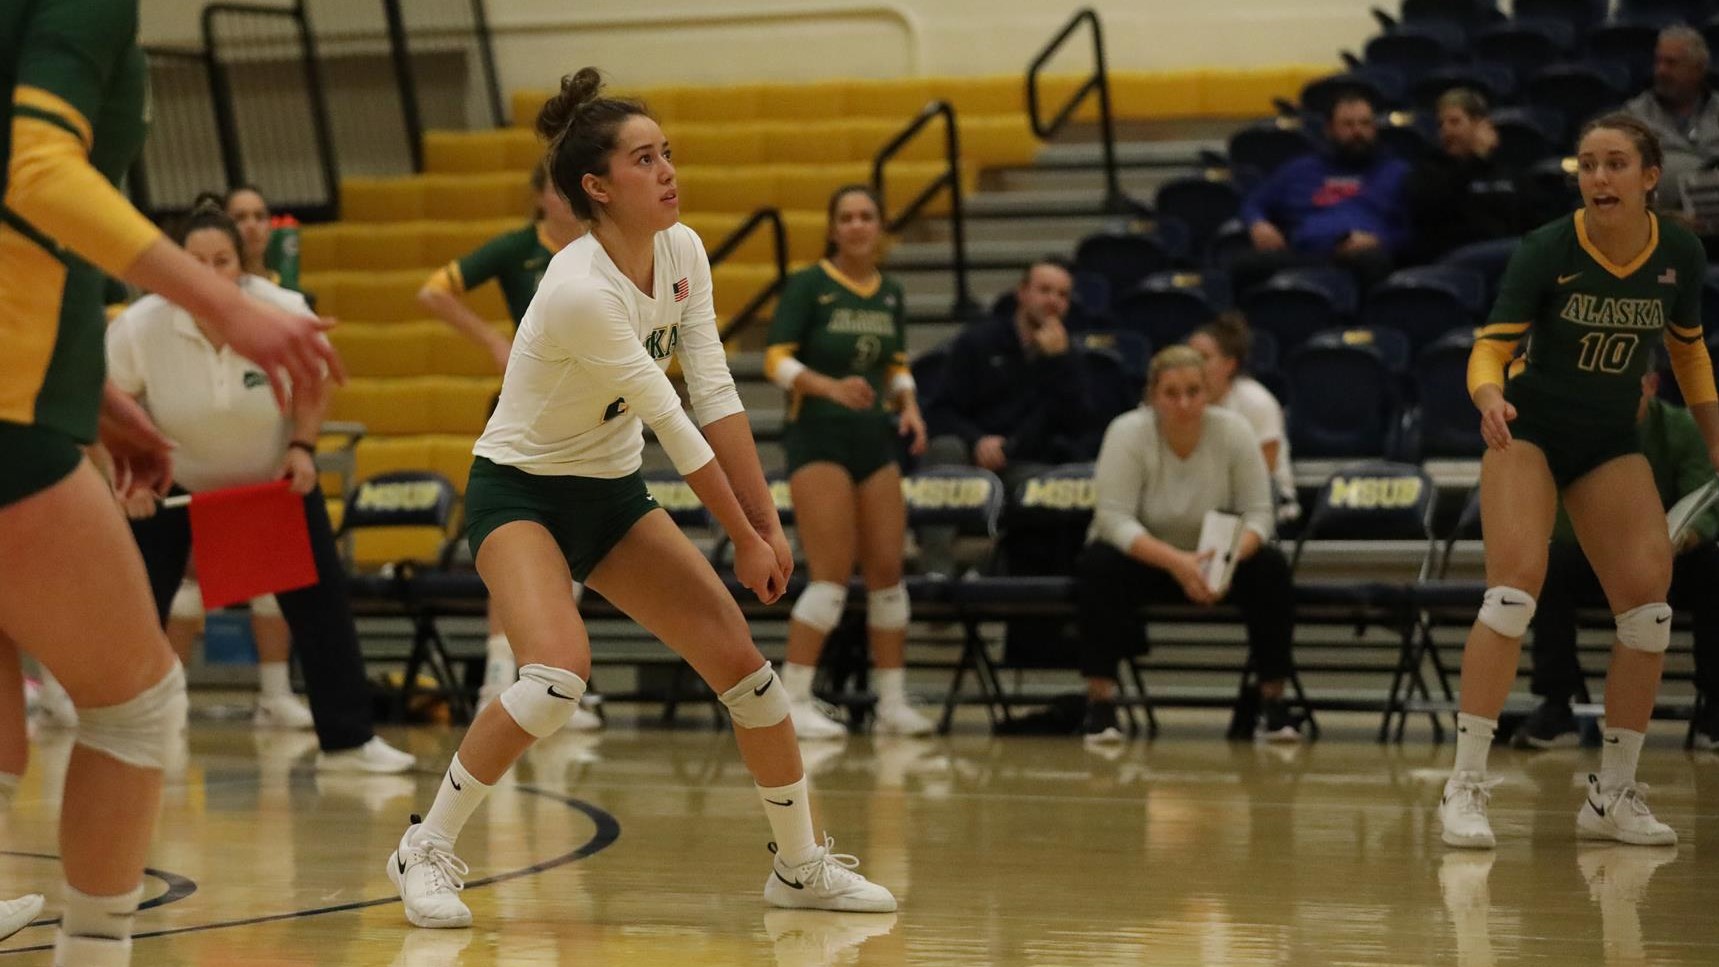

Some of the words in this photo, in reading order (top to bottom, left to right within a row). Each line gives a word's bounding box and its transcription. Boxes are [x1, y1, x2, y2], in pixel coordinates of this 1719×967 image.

[1560, 292, 1664, 329] ALASKA
[1578, 332, 1639, 373] 10
[1022, 477, 1097, 509] MSU
[1328, 476, 1422, 509] MSUB
